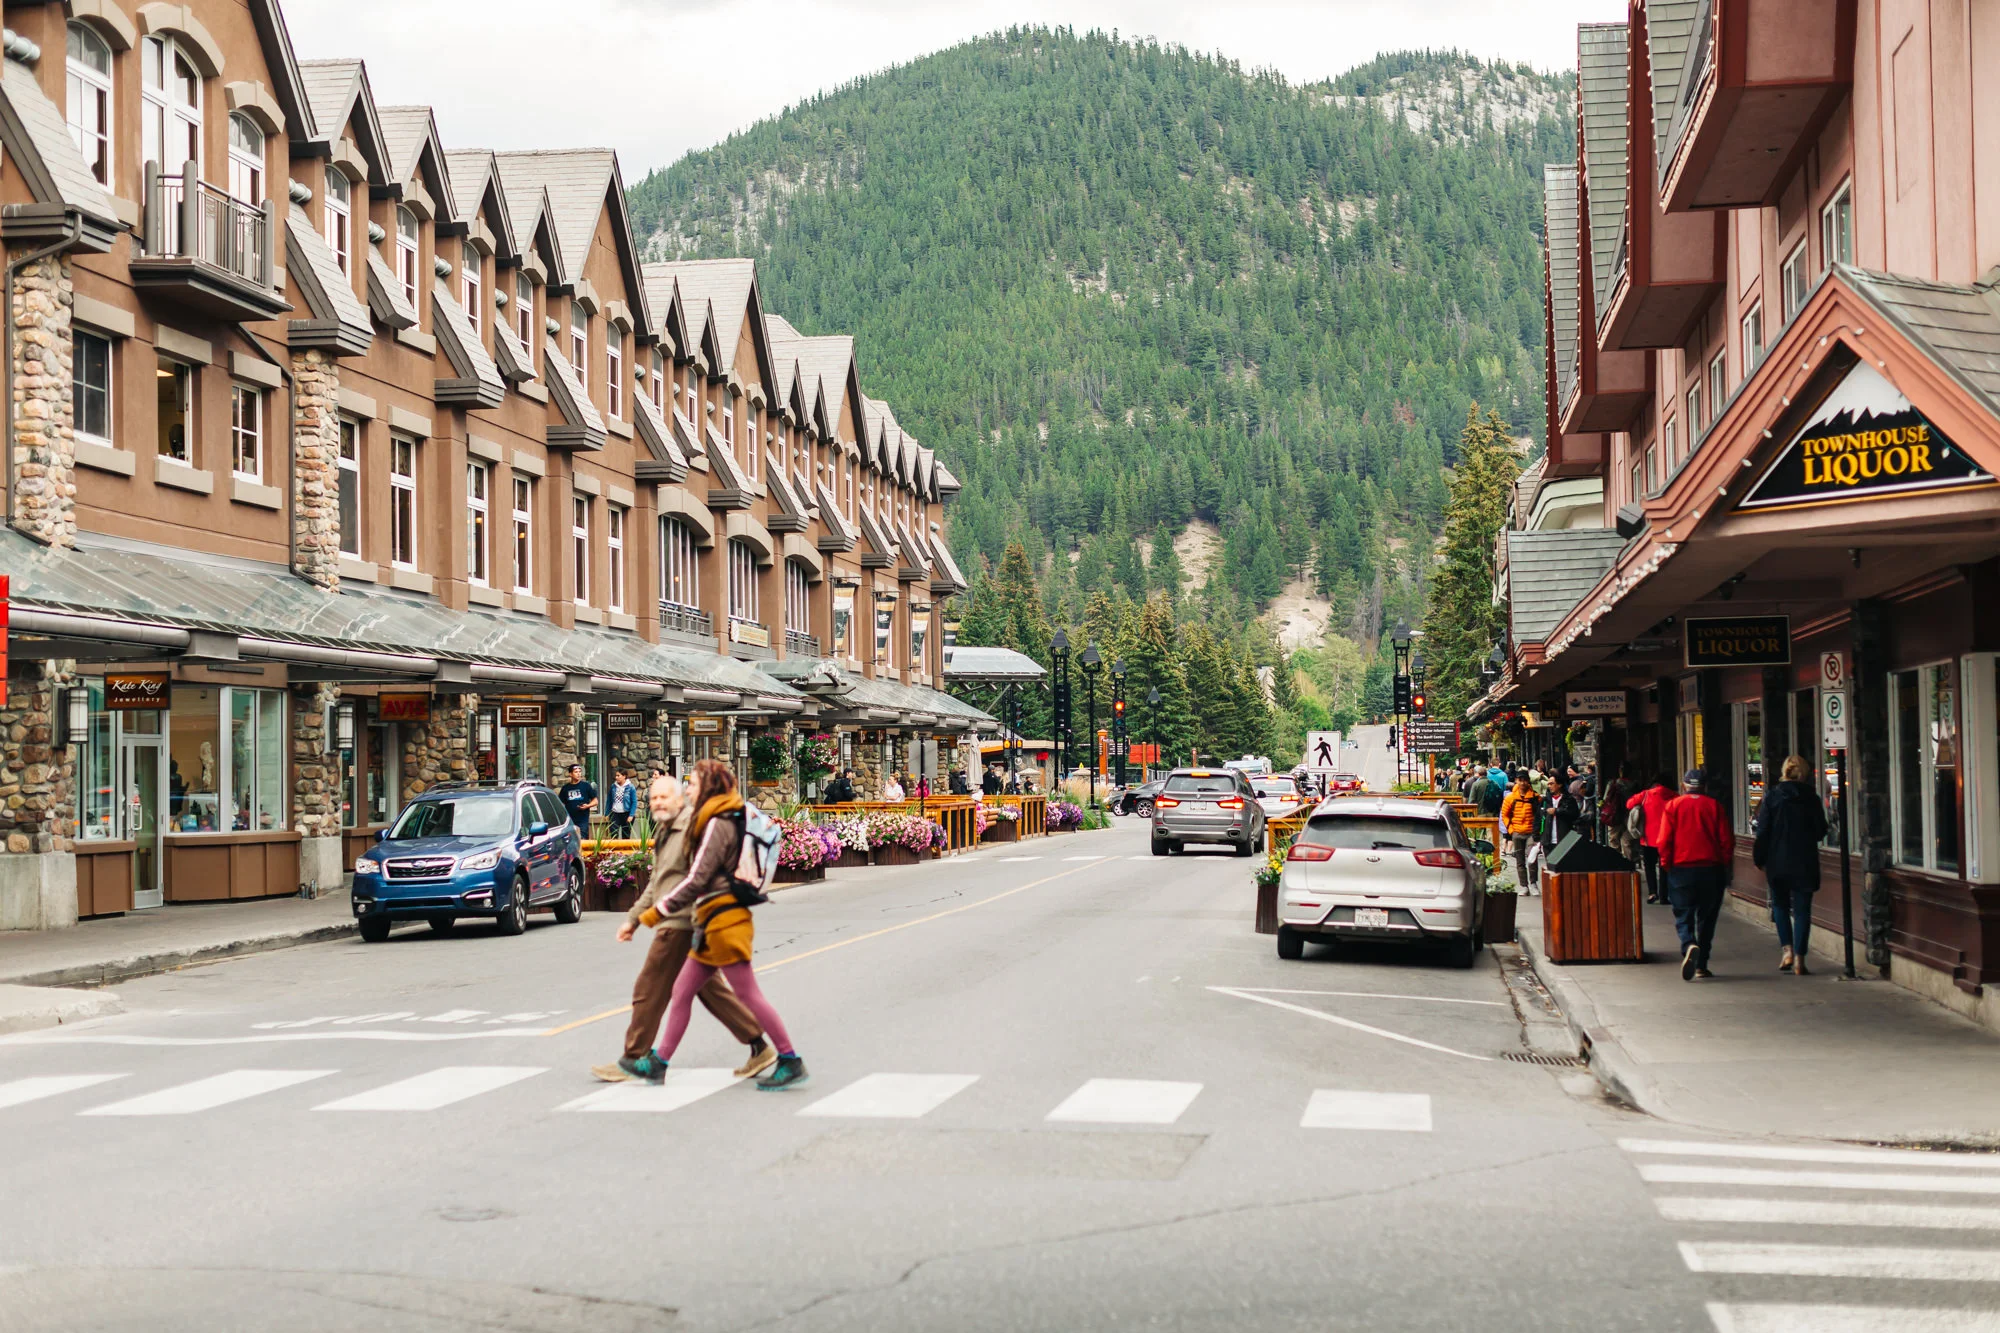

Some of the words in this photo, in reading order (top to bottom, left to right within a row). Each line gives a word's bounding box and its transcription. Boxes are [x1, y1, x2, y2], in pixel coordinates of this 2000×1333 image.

[1801, 425, 1930, 456] TOWNHOUSE
[1803, 444, 1934, 485] LIQUOR
[1696, 625, 1777, 637] TOWNHOUSE
[1697, 638, 1781, 656] LIQUOR
[112, 679, 136, 693] Kate
[138, 679, 162, 695] King
[384, 699, 425, 716] AVIS
[1583, 695, 1624, 703] SEABORN
